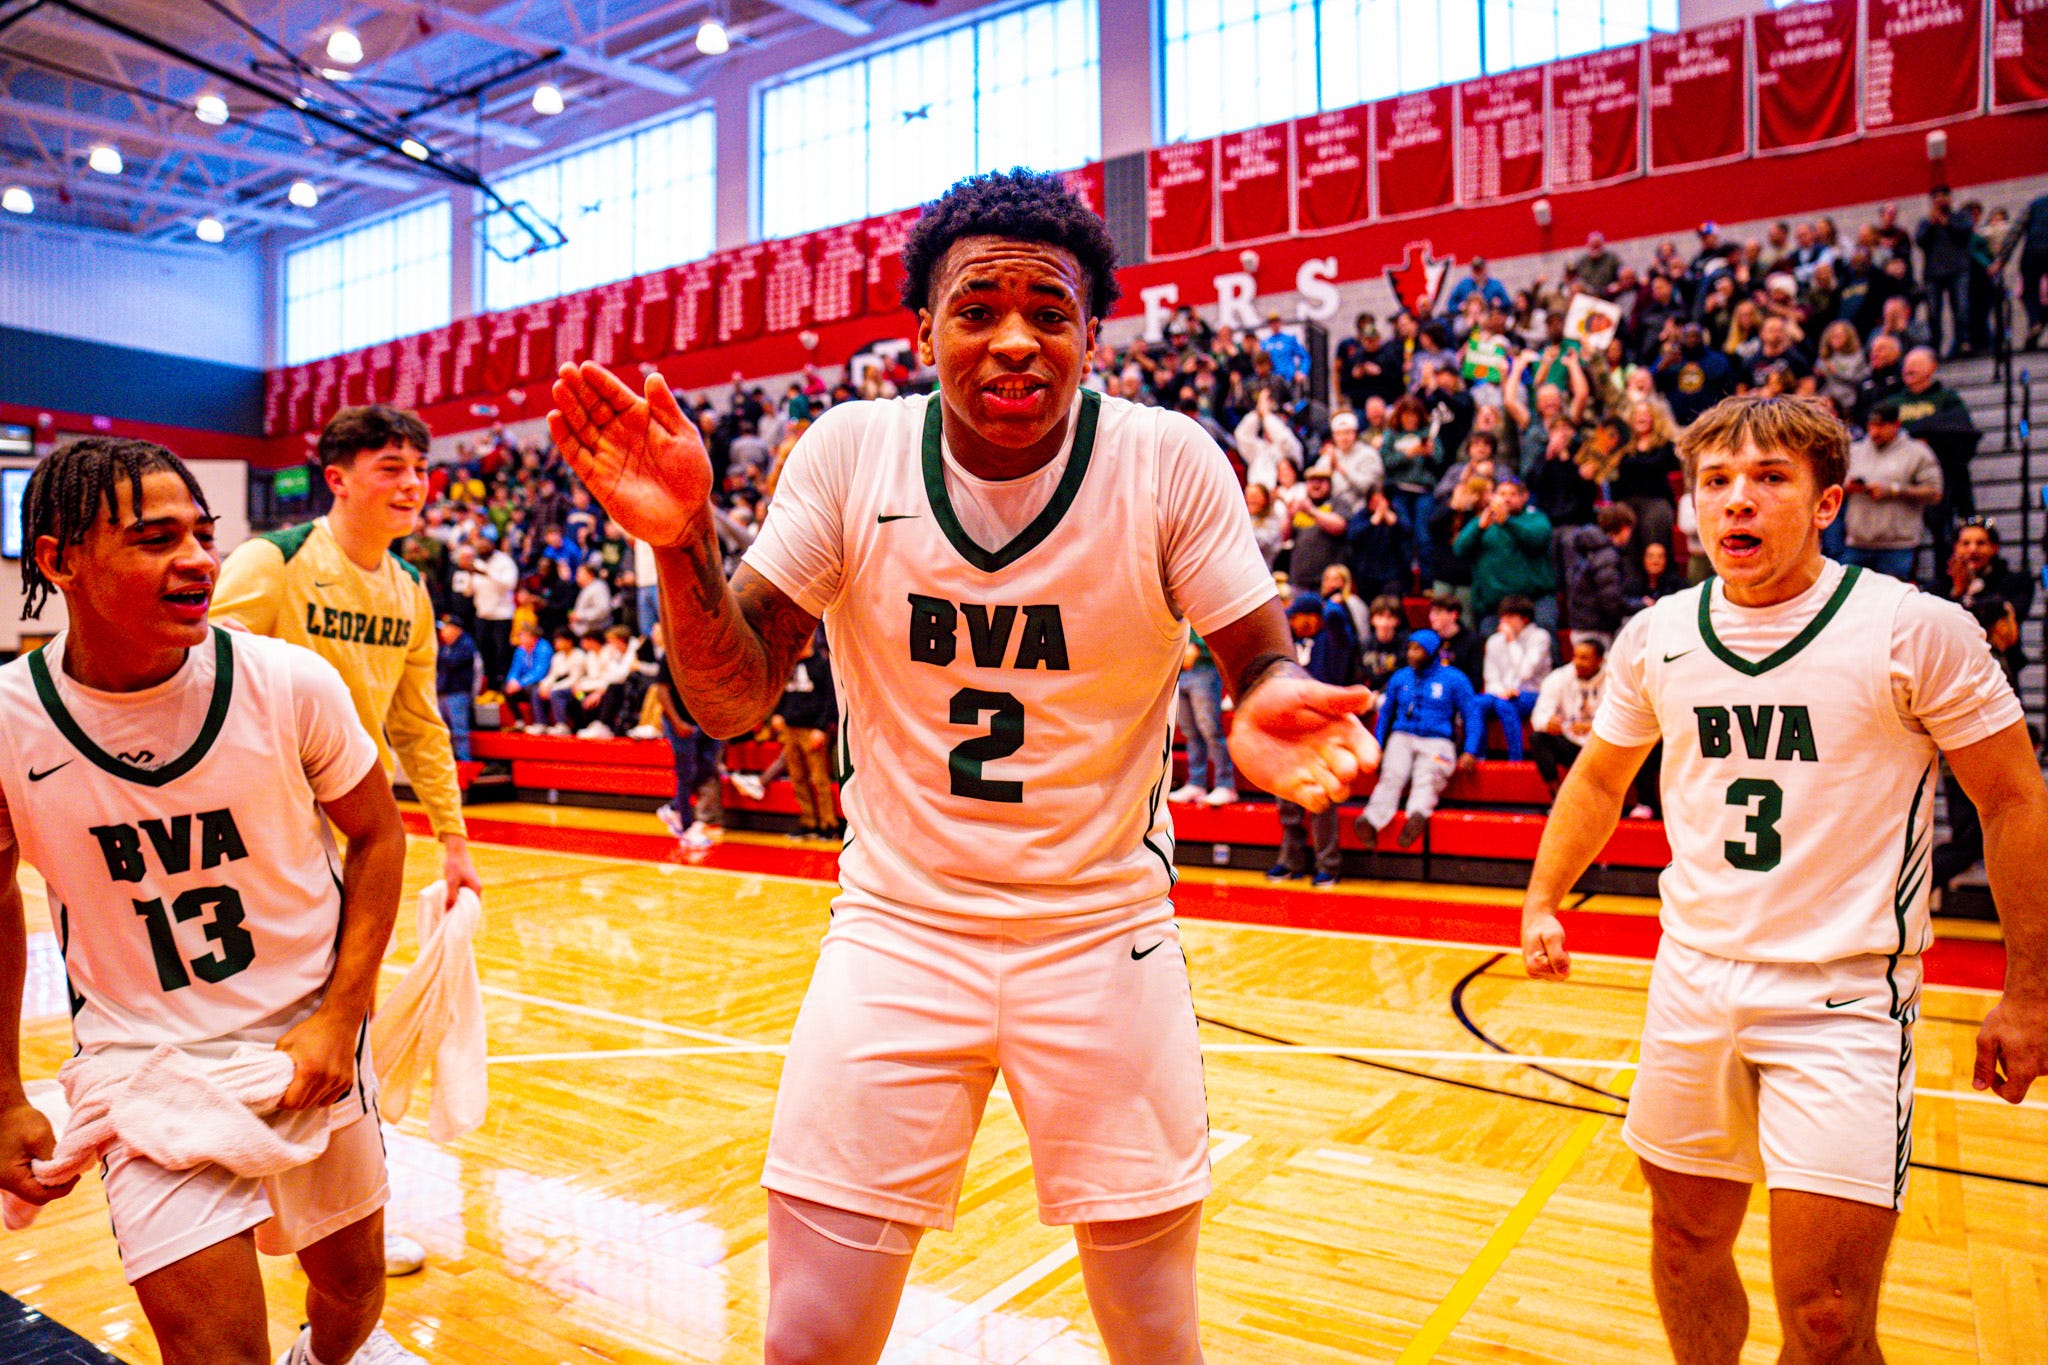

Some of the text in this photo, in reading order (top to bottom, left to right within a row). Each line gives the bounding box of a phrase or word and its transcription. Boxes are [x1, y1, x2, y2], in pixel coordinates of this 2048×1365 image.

[907, 592, 1070, 671] BVA
[948, 687, 1025, 803] 2
[1692, 704, 1819, 763] BVA
[89, 807, 249, 883] BVA
[1724, 777, 1783, 873] 3
[132, 884, 256, 992] 13
